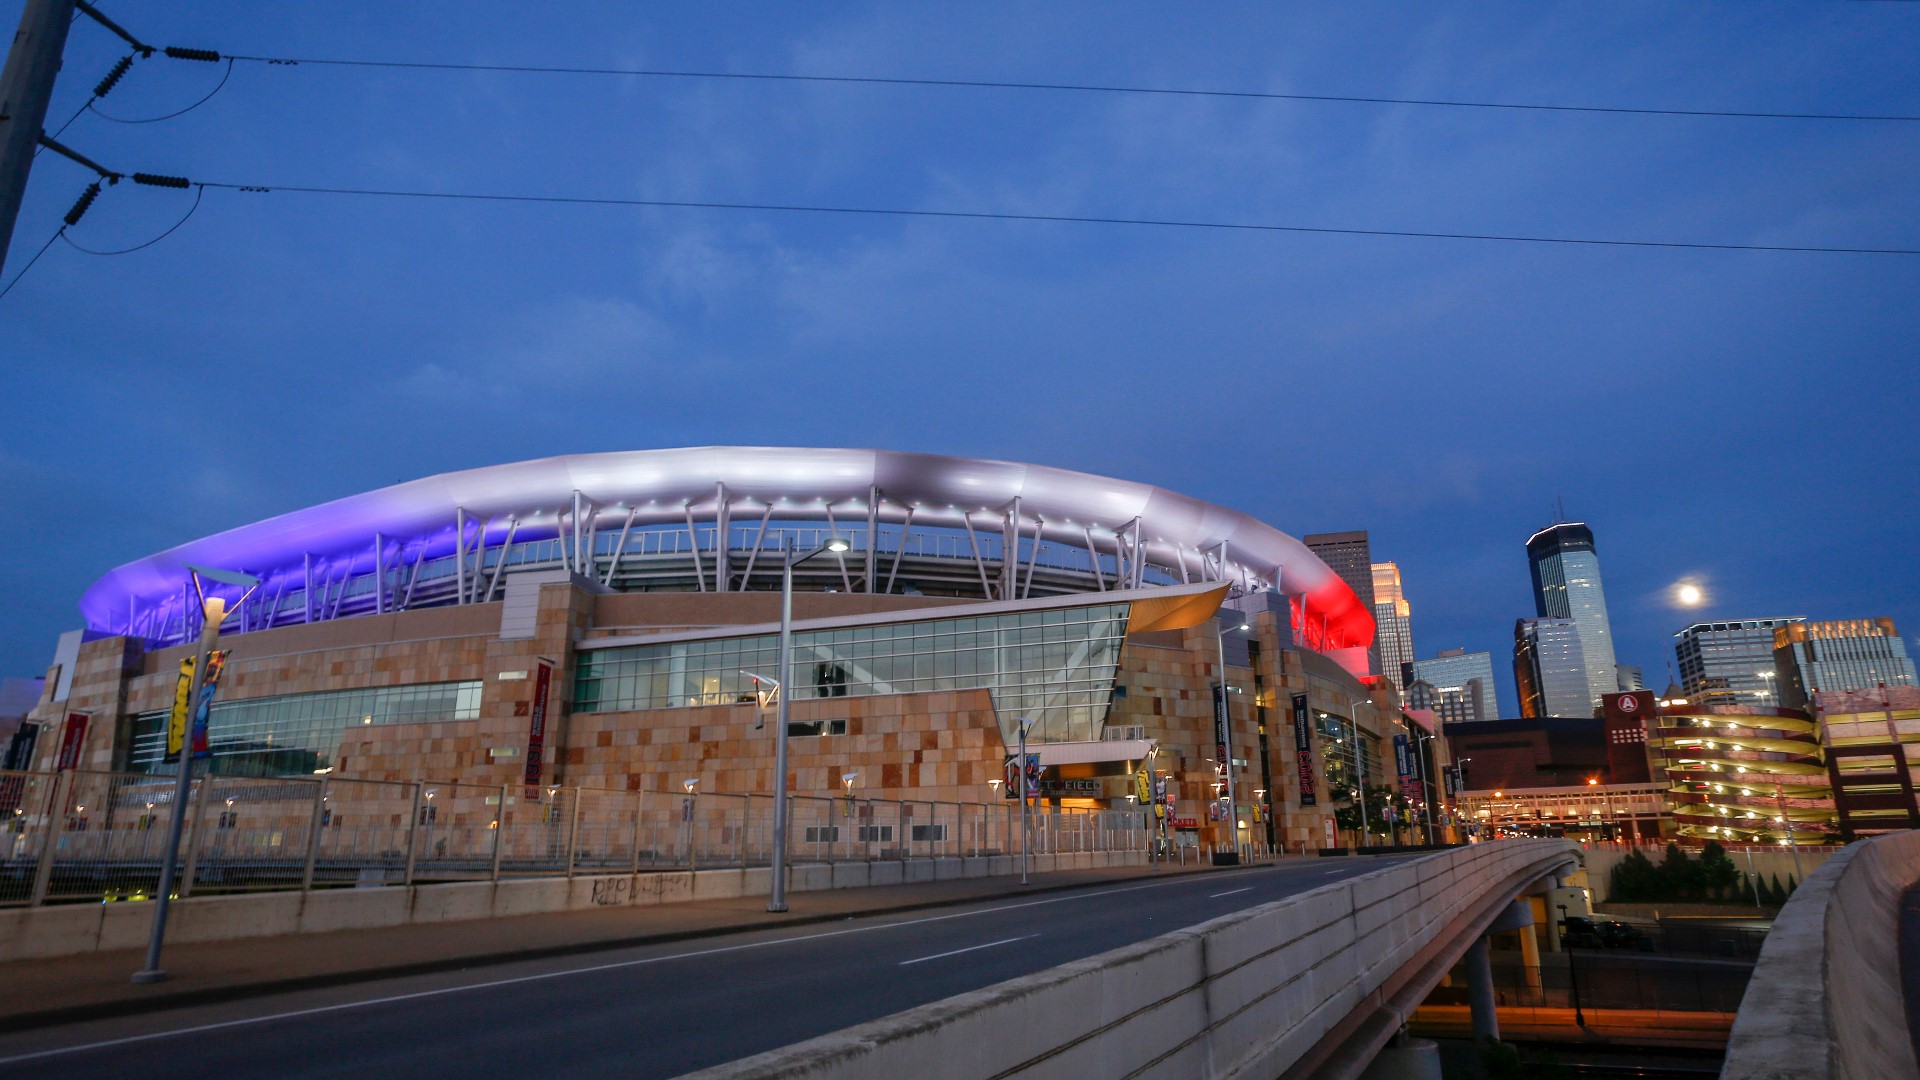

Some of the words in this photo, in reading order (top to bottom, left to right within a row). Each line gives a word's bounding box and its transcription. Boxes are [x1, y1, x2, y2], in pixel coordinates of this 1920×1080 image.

[1622, 697, 1635, 708] A
[525, 741, 542, 784] 1991
[1297, 750, 1315, 794] 2003
[1065, 781, 1102, 790] FIELD
[1167, 817, 1198, 826] ICKETS
